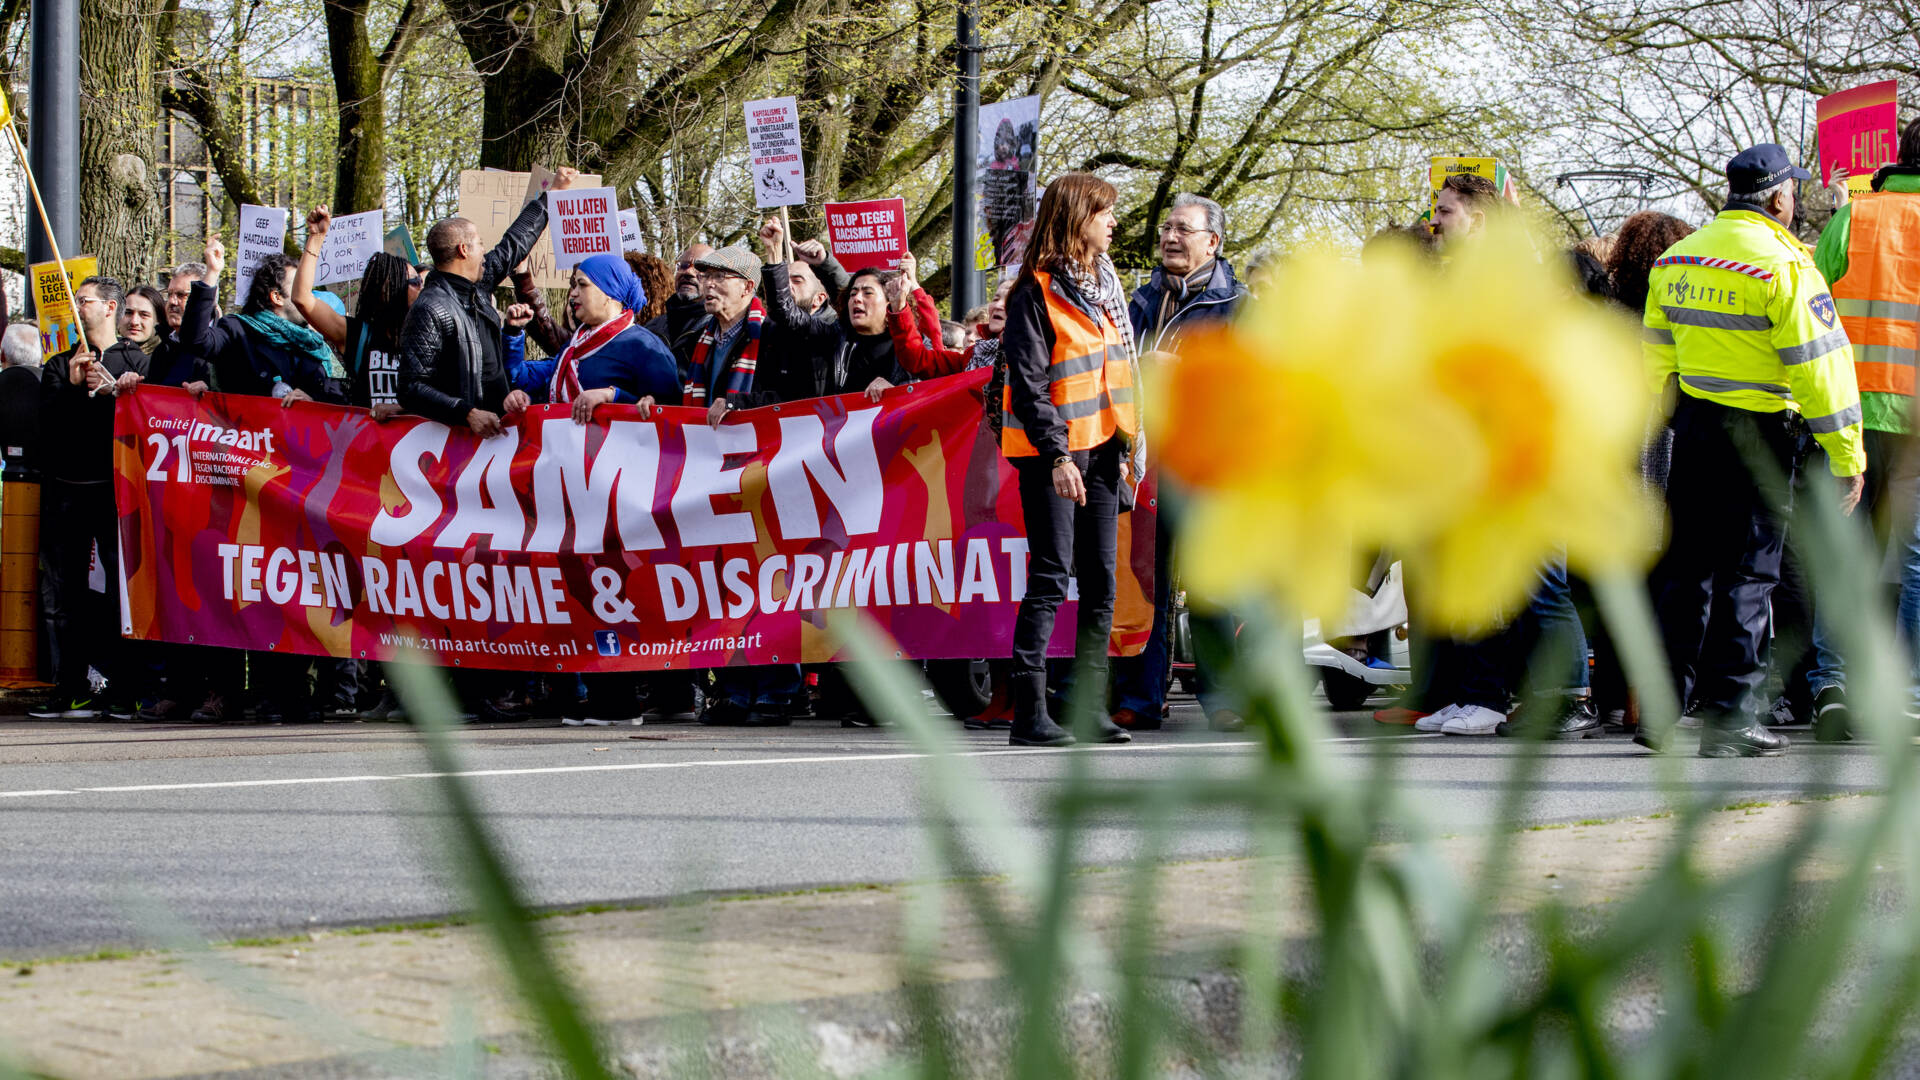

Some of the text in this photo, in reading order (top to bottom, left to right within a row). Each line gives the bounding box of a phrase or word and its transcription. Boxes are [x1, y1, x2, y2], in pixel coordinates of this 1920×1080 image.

[1851, 129, 1890, 169] HUG
[467, 175, 486, 194] OH
[557, 198, 608, 216] WIJ LATEN
[255, 218, 270, 229] GEEF
[330, 217, 364, 231] WEG MET
[562, 217, 606, 235] ONS NIET
[831, 210, 895, 227] STA OP TEGEN
[243, 233, 279, 248] HAATZAAIERS
[835, 224, 892, 240] RACISME EN
[562, 236, 611, 254] VERDELEN
[834, 238, 900, 254] DISCRIMINATIE
[320, 260, 365, 281] DUMMIE
[42, 290, 75, 304] RACIS
[148, 416, 189, 430] Comité
[146, 422, 275, 482] 21 maart
[192, 451, 272, 469] INTERNATIONALE DAG
[194, 462, 248, 476] TEGEN RACISME &
[195, 475, 240, 486] DISCRIMINATIE
[370, 406, 883, 554] SAMEN
[217, 537, 1079, 625] TEGEN RACISME & DISCRIMINAT
[380, 632, 578, 657] www.21maartcomite.nl
[628, 631, 763, 657] comite21maart
